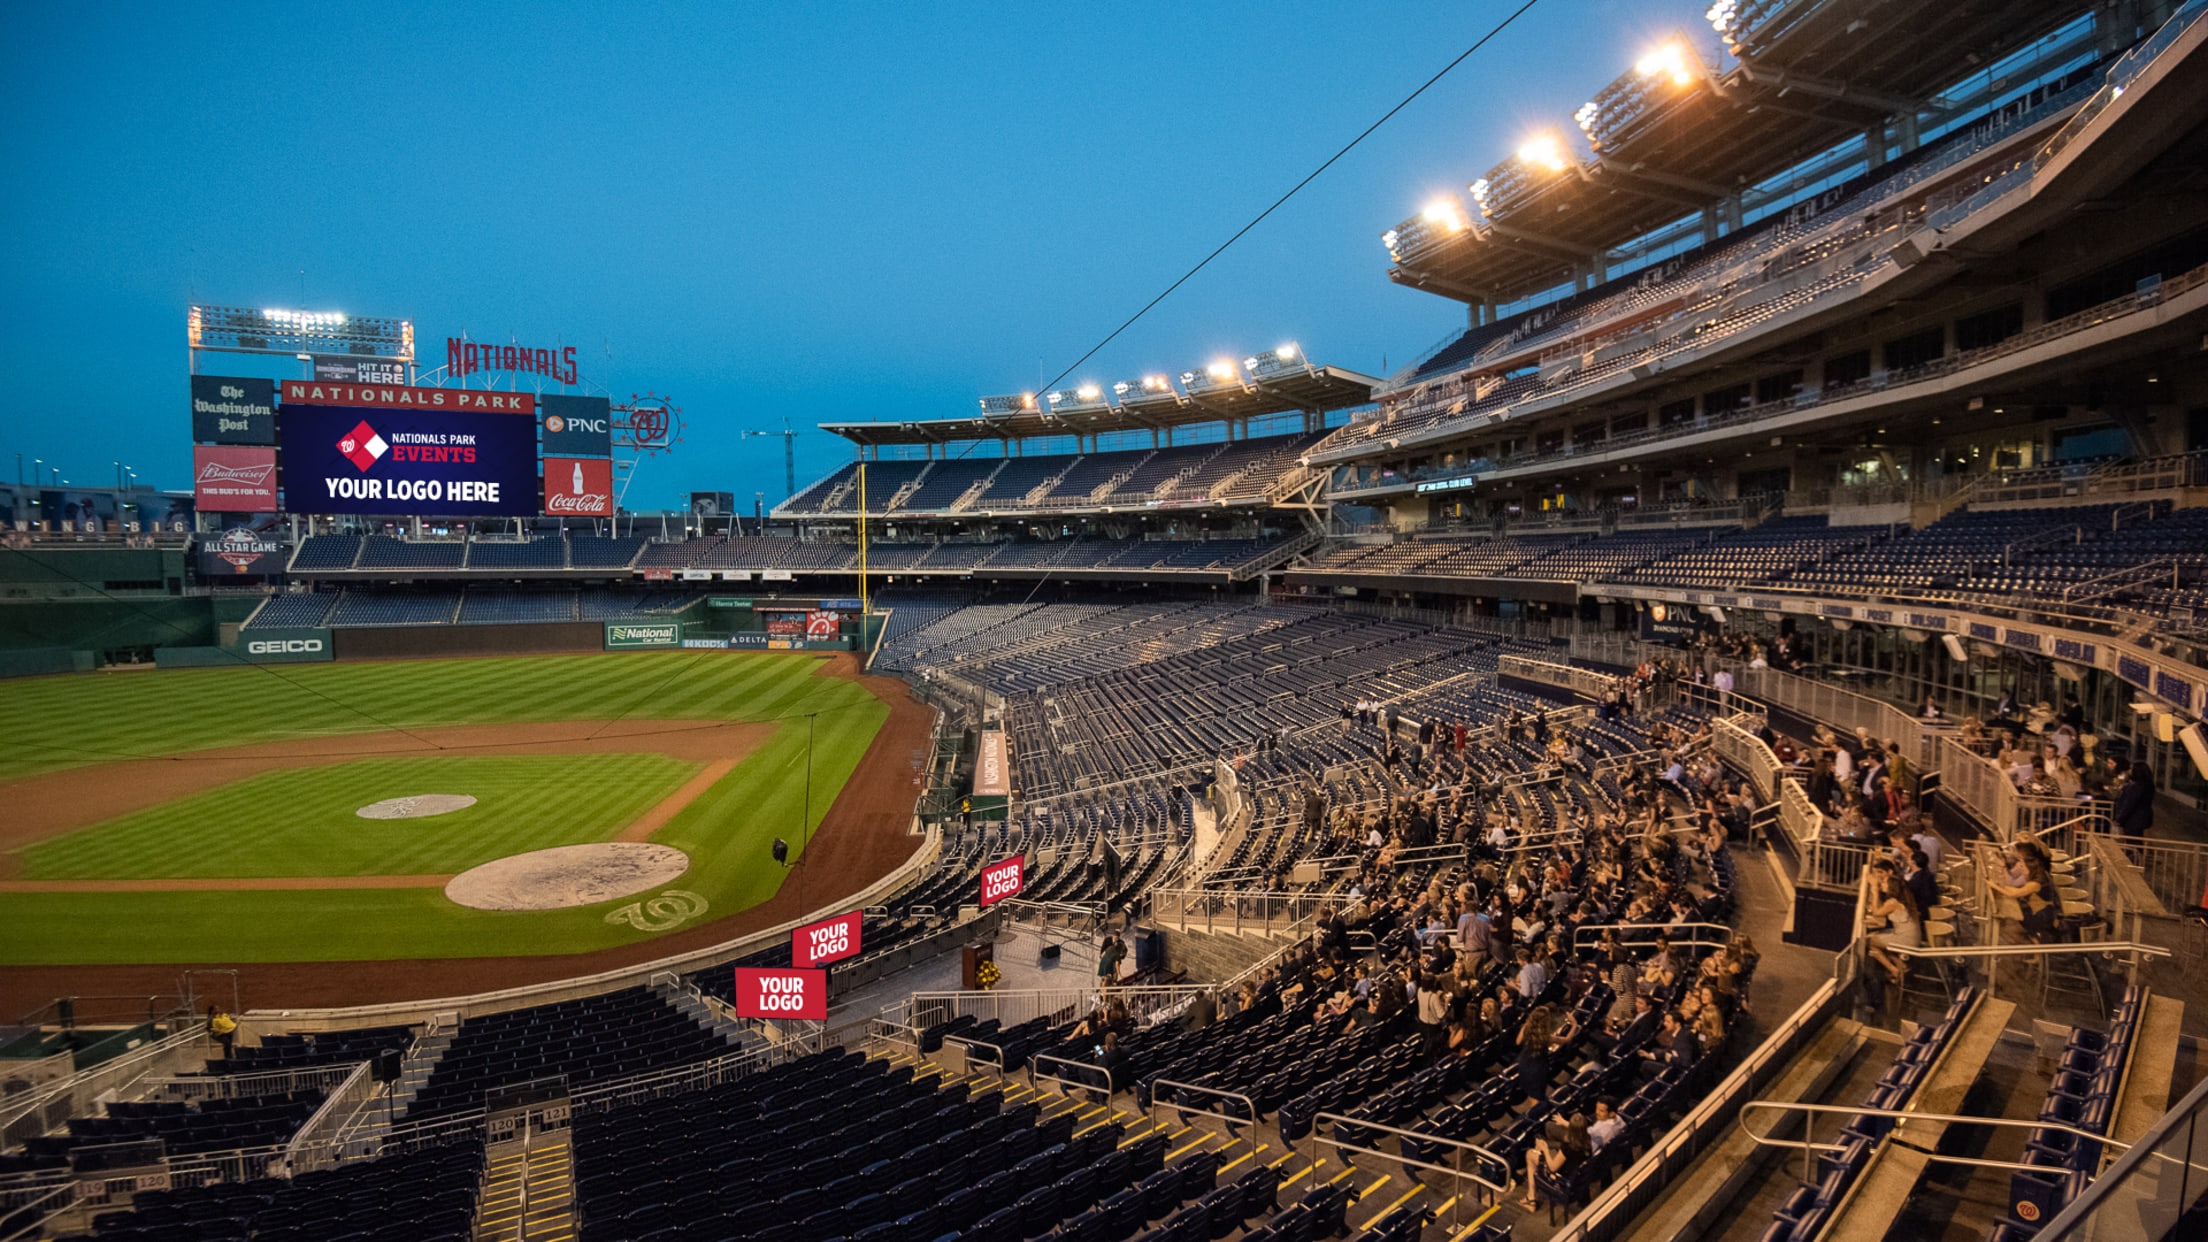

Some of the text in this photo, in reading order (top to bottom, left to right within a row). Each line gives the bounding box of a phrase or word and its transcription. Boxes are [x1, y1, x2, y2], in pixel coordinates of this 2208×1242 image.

[357, 362, 378, 372] HIT
[380, 364, 392, 372] IT
[447, 337, 577, 385] NATIONALS
[358, 371, 404, 385] HERE
[220, 385, 245, 399] The
[291, 385, 522, 409] NATIONALS PARK
[194, 397, 271, 417] Washington
[219, 418, 249, 433] Post
[566, 417, 607, 434] PNC
[392, 433, 476, 445] NATIONALS PARK
[392, 445, 477, 463] EVENTS
[203, 466, 267, 479] Budweiser
[325, 477, 500, 503] YOUR LOGO HERE
[204, 542, 277, 553] ALL STAR GAME
[1667, 605, 1697, 623] PNC
[627, 627, 673, 639] National
[739, 636, 767, 644] DELTA
[248, 639, 323, 654] GEICO
[986, 864, 1019, 885] YOUR
[986, 878, 1019, 899] LOGO
[809, 922, 849, 944] YOUR
[810, 938, 849, 961] LOGO
[759, 977, 804, 993] YOUR
[759, 994, 804, 1011] LOGO
[491, 1107, 567, 1132] 120 121
[140, 1175, 166, 1188] 120
